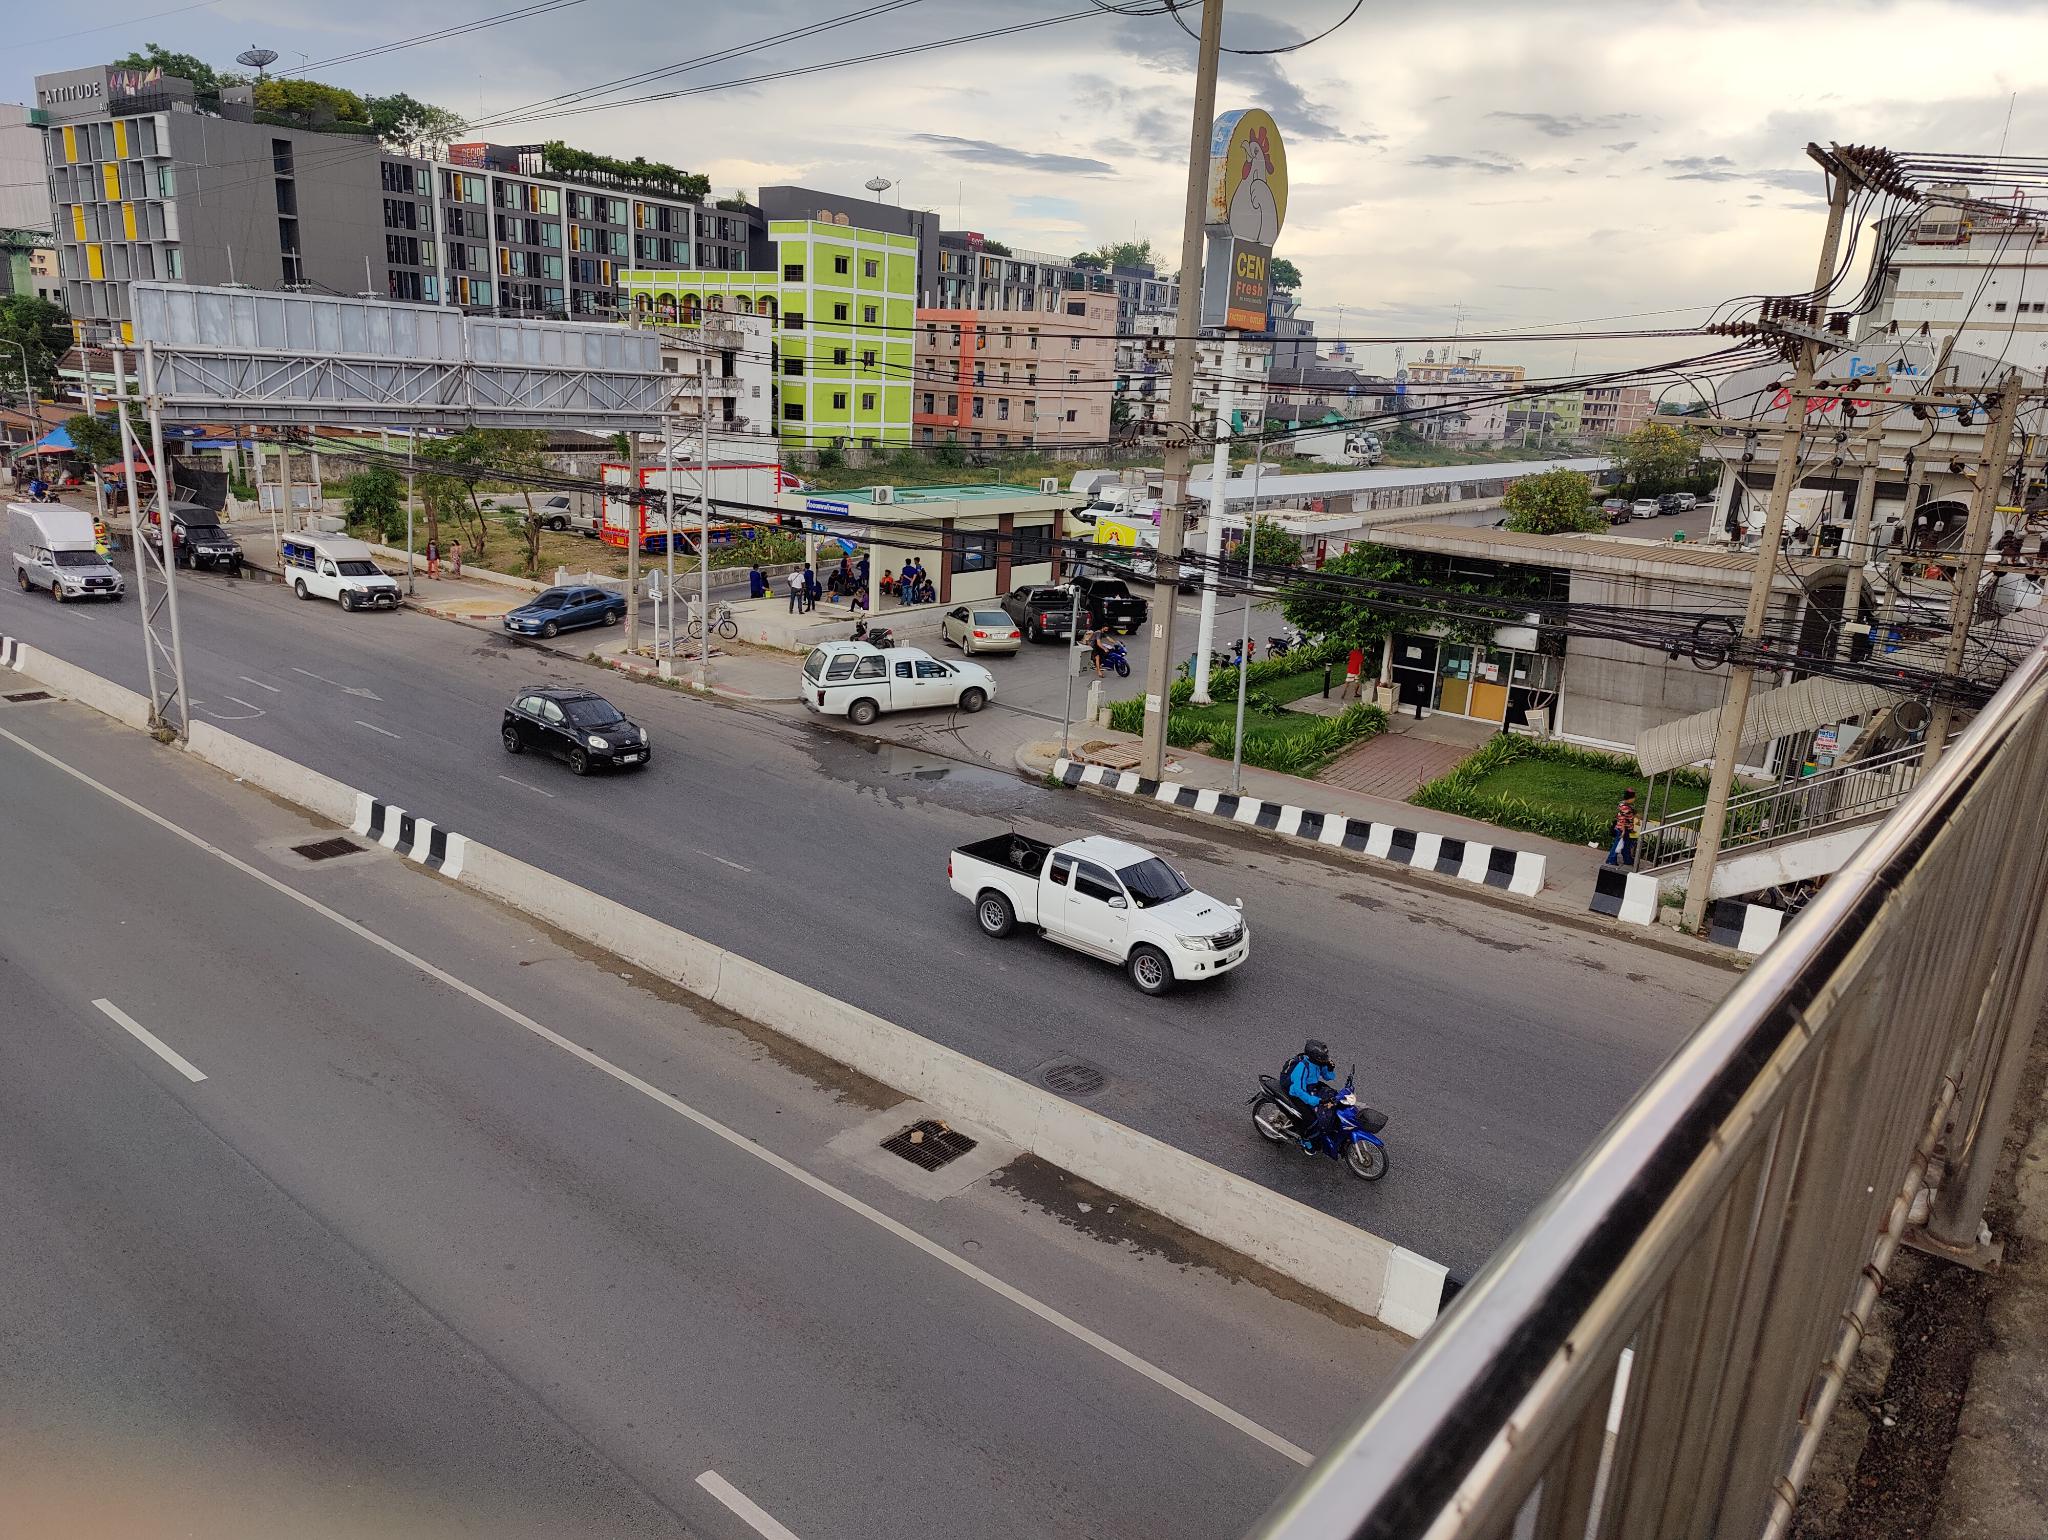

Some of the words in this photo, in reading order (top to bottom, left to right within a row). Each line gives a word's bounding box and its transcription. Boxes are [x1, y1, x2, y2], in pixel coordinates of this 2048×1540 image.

[45, 81, 101, 104] ATTITUDE
[462, 147, 486, 157] DECIDE
[1236, 252, 1265, 280] CEN
[1235, 281, 1263, 297] Fresh
